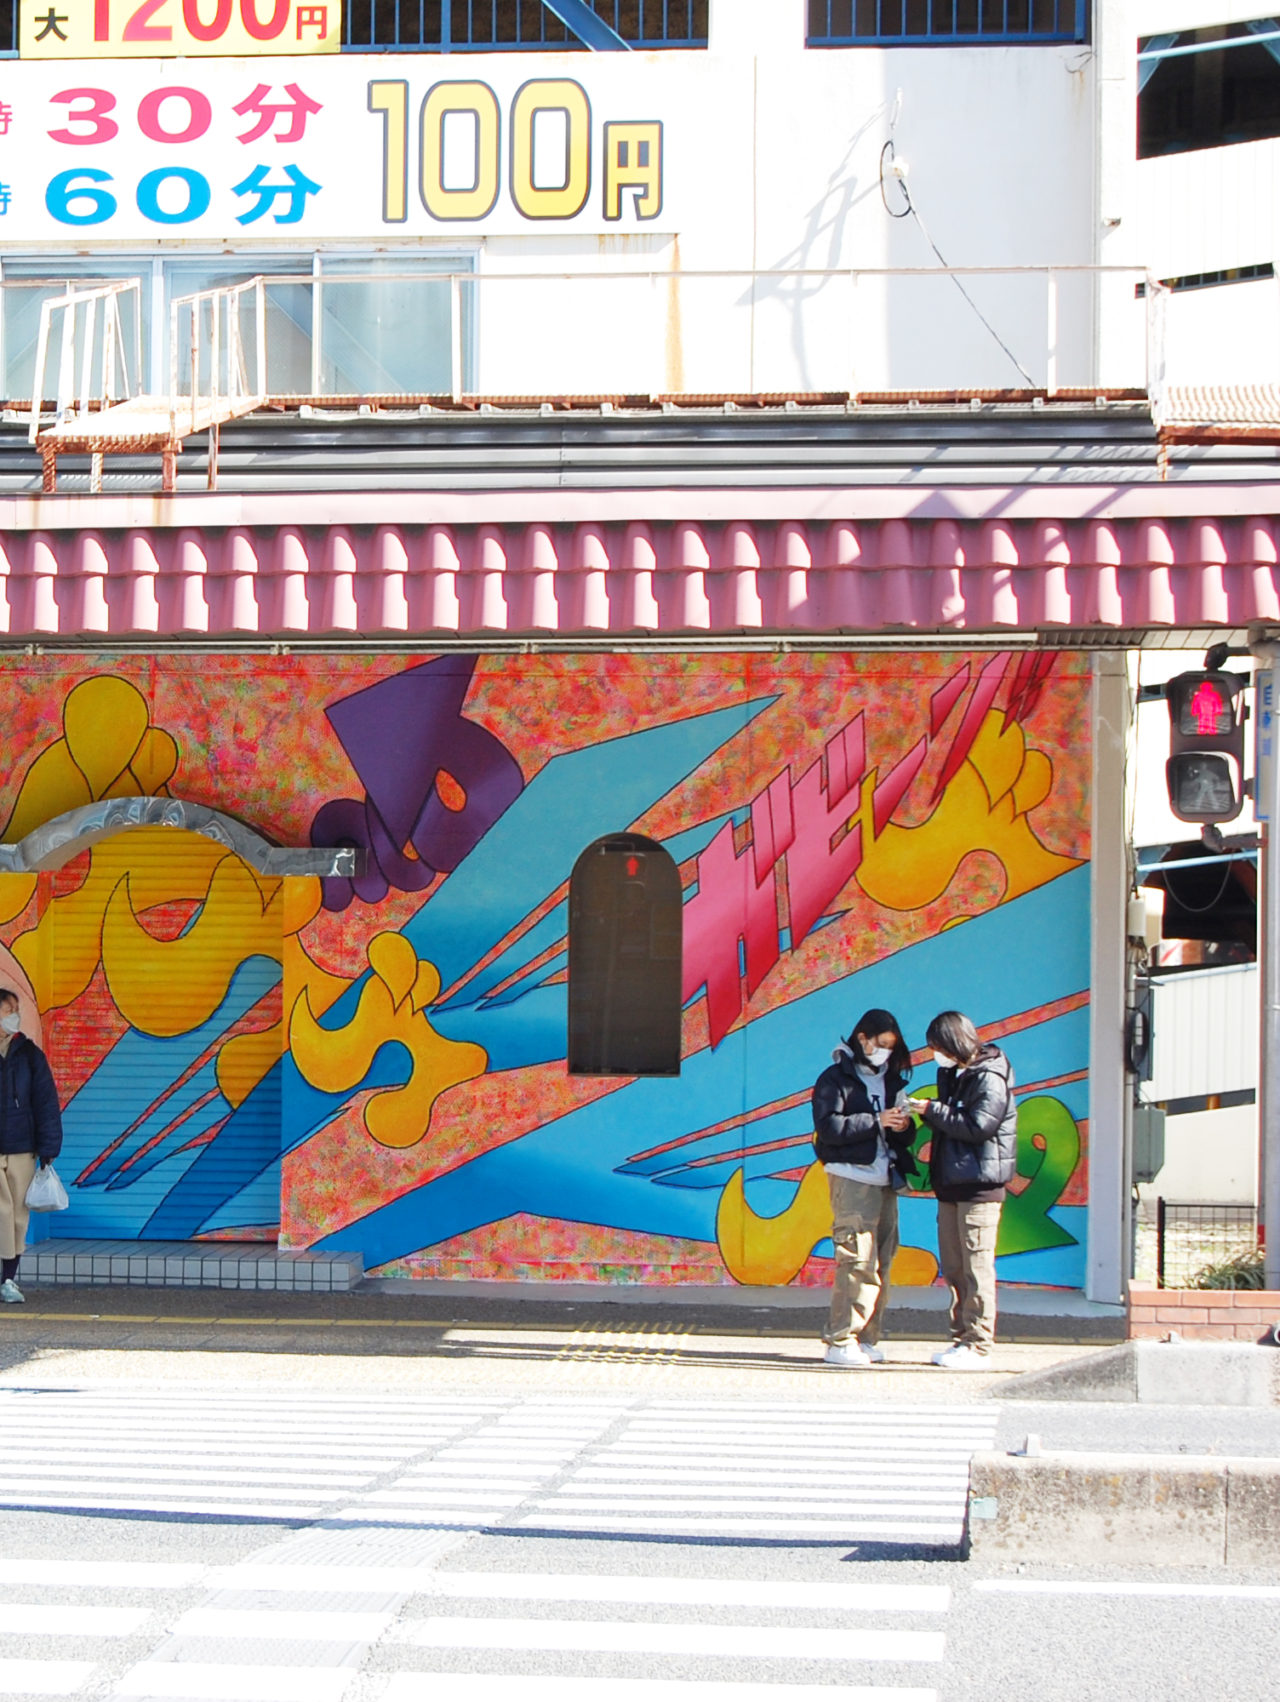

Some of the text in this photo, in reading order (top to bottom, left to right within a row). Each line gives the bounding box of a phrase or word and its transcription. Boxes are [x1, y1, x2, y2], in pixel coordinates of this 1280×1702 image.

[34, 8, 69, 41] 大
[46, 82, 324, 145] 30分
[367, 77, 664, 223] 100円
[45, 164, 323, 226] 60分
